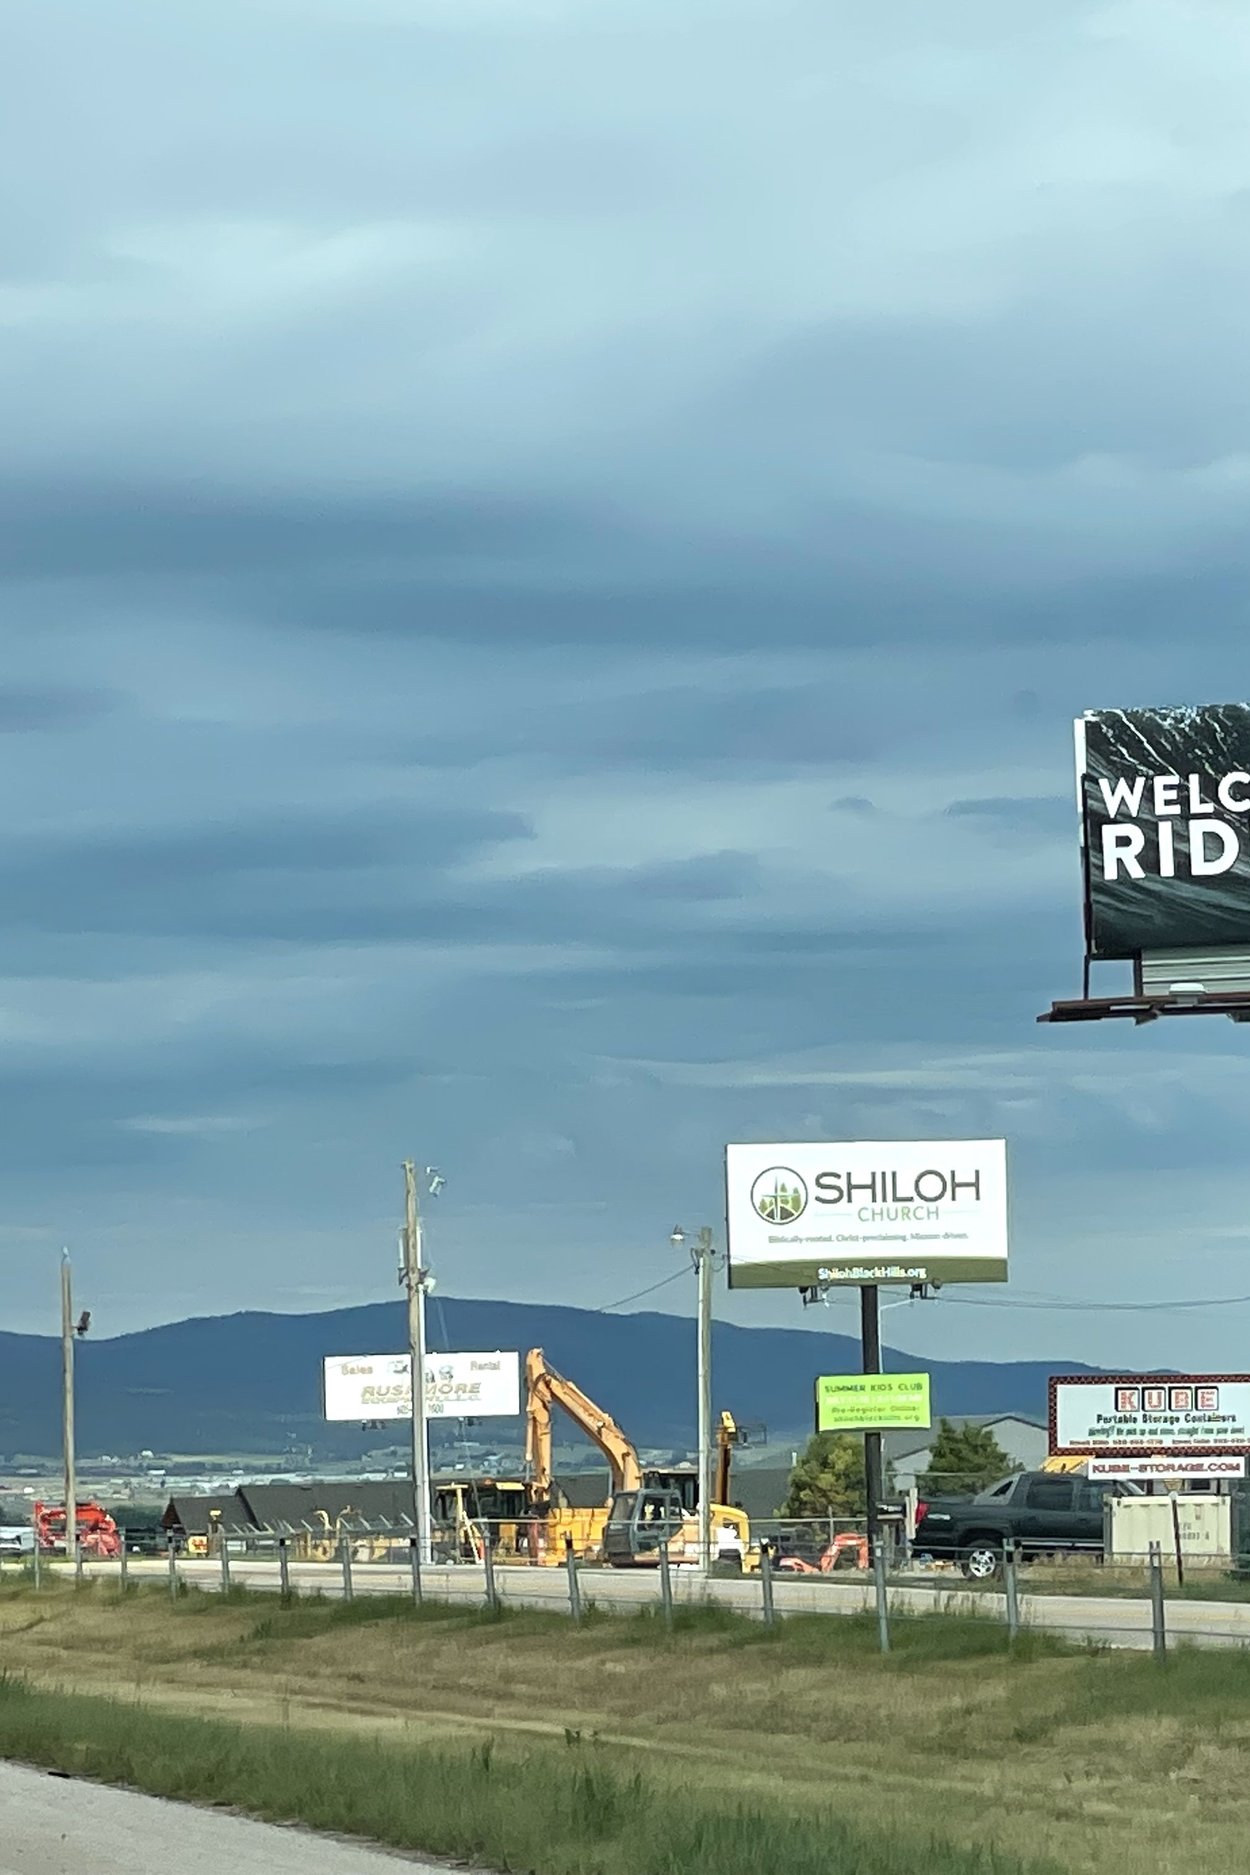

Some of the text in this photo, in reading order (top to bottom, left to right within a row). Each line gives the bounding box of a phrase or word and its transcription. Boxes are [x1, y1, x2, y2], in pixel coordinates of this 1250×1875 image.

[814, 1169, 981, 1204] SHILOH
[857, 1206, 940, 1222] CHURCH
[360, 1382, 482, 1397] RUSMORE
[824, 1382, 923, 1393] SUMMER KIDS CLUB
[1120, 1391, 1215, 1409] KUBE
[1096, 1413, 1138, 1424] Portable
[1142, 1414, 1181, 1425] Storage
[1091, 1463, 1241, 1475] KUBE-STORAGE.COM
